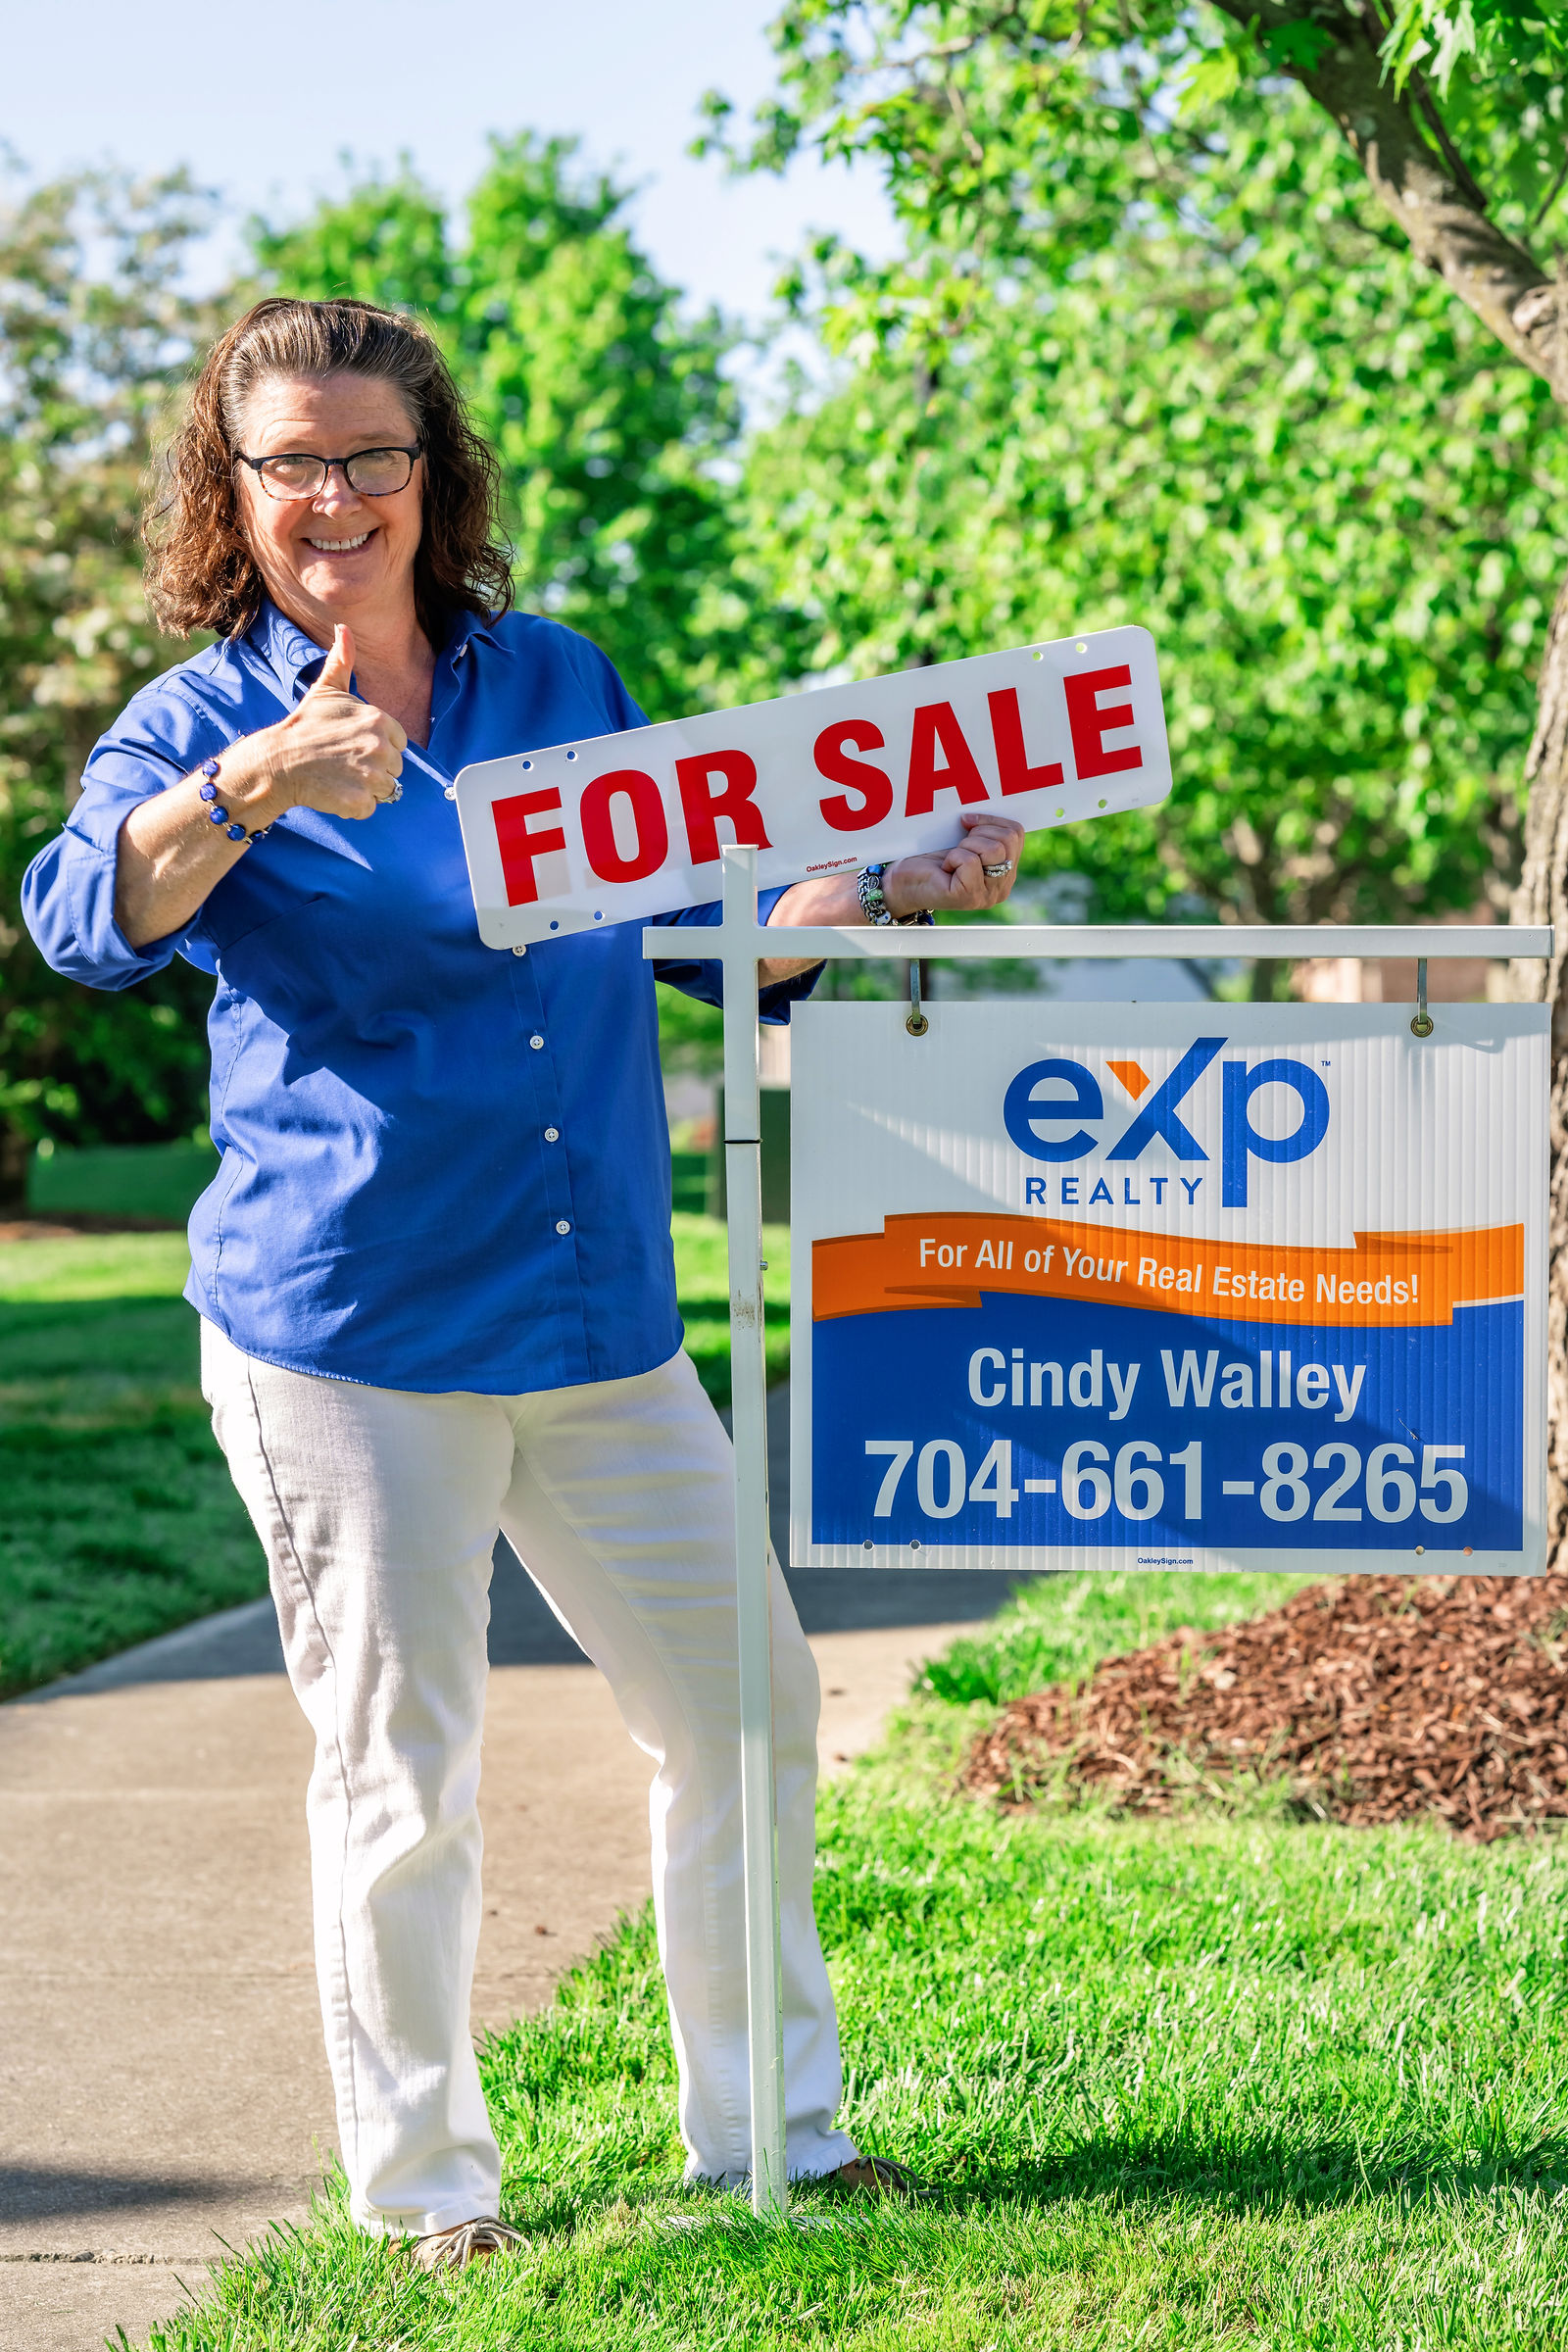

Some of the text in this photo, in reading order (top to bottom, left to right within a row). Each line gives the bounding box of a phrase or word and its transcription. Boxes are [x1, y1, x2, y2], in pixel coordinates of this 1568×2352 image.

[492, 664, 1142, 906] FOR SALE
[806, 857, 858, 872] OakleySign.com
[1025, 1177, 1203, 1205] REALTY
[919, 1239, 1418, 1304] For All of Your Real Estate Needs!
[968, 1348, 1367, 1423] Cindy Walley
[864, 1439, 1469, 1524] 704-661-8265
